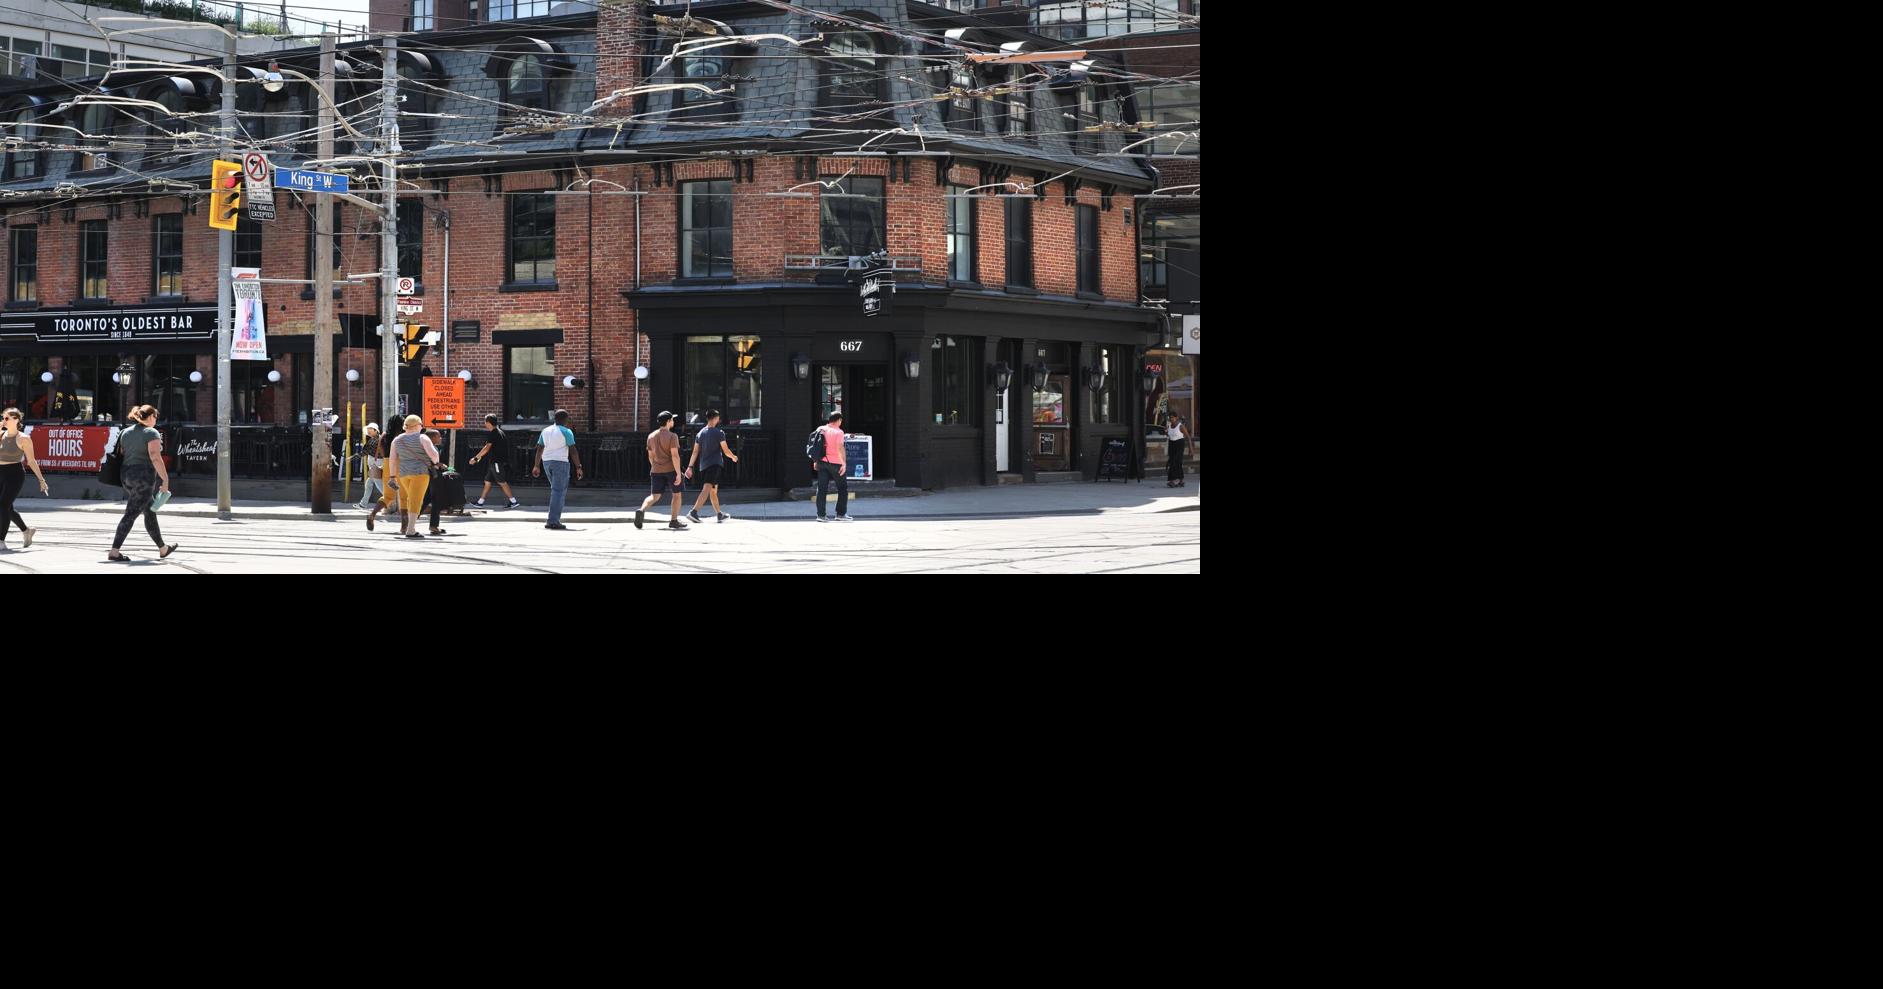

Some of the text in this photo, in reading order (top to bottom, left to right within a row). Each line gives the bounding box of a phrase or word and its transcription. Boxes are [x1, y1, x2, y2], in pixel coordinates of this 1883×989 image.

[291, 171, 332, 190] King St W
[251, 210, 274, 218] EXCEPTED
[54, 315, 193, 332] TORONTO'S OLDEST BAR
[110, 331, 122, 339] SINCE
[840, 341, 863, 351] 667
[48, 429, 84, 439] OUT OF OFFICE
[48, 439, 83, 457] HOURS
[190, 439, 198, 447] The
[177, 441, 218, 456] Wheatsheaf
